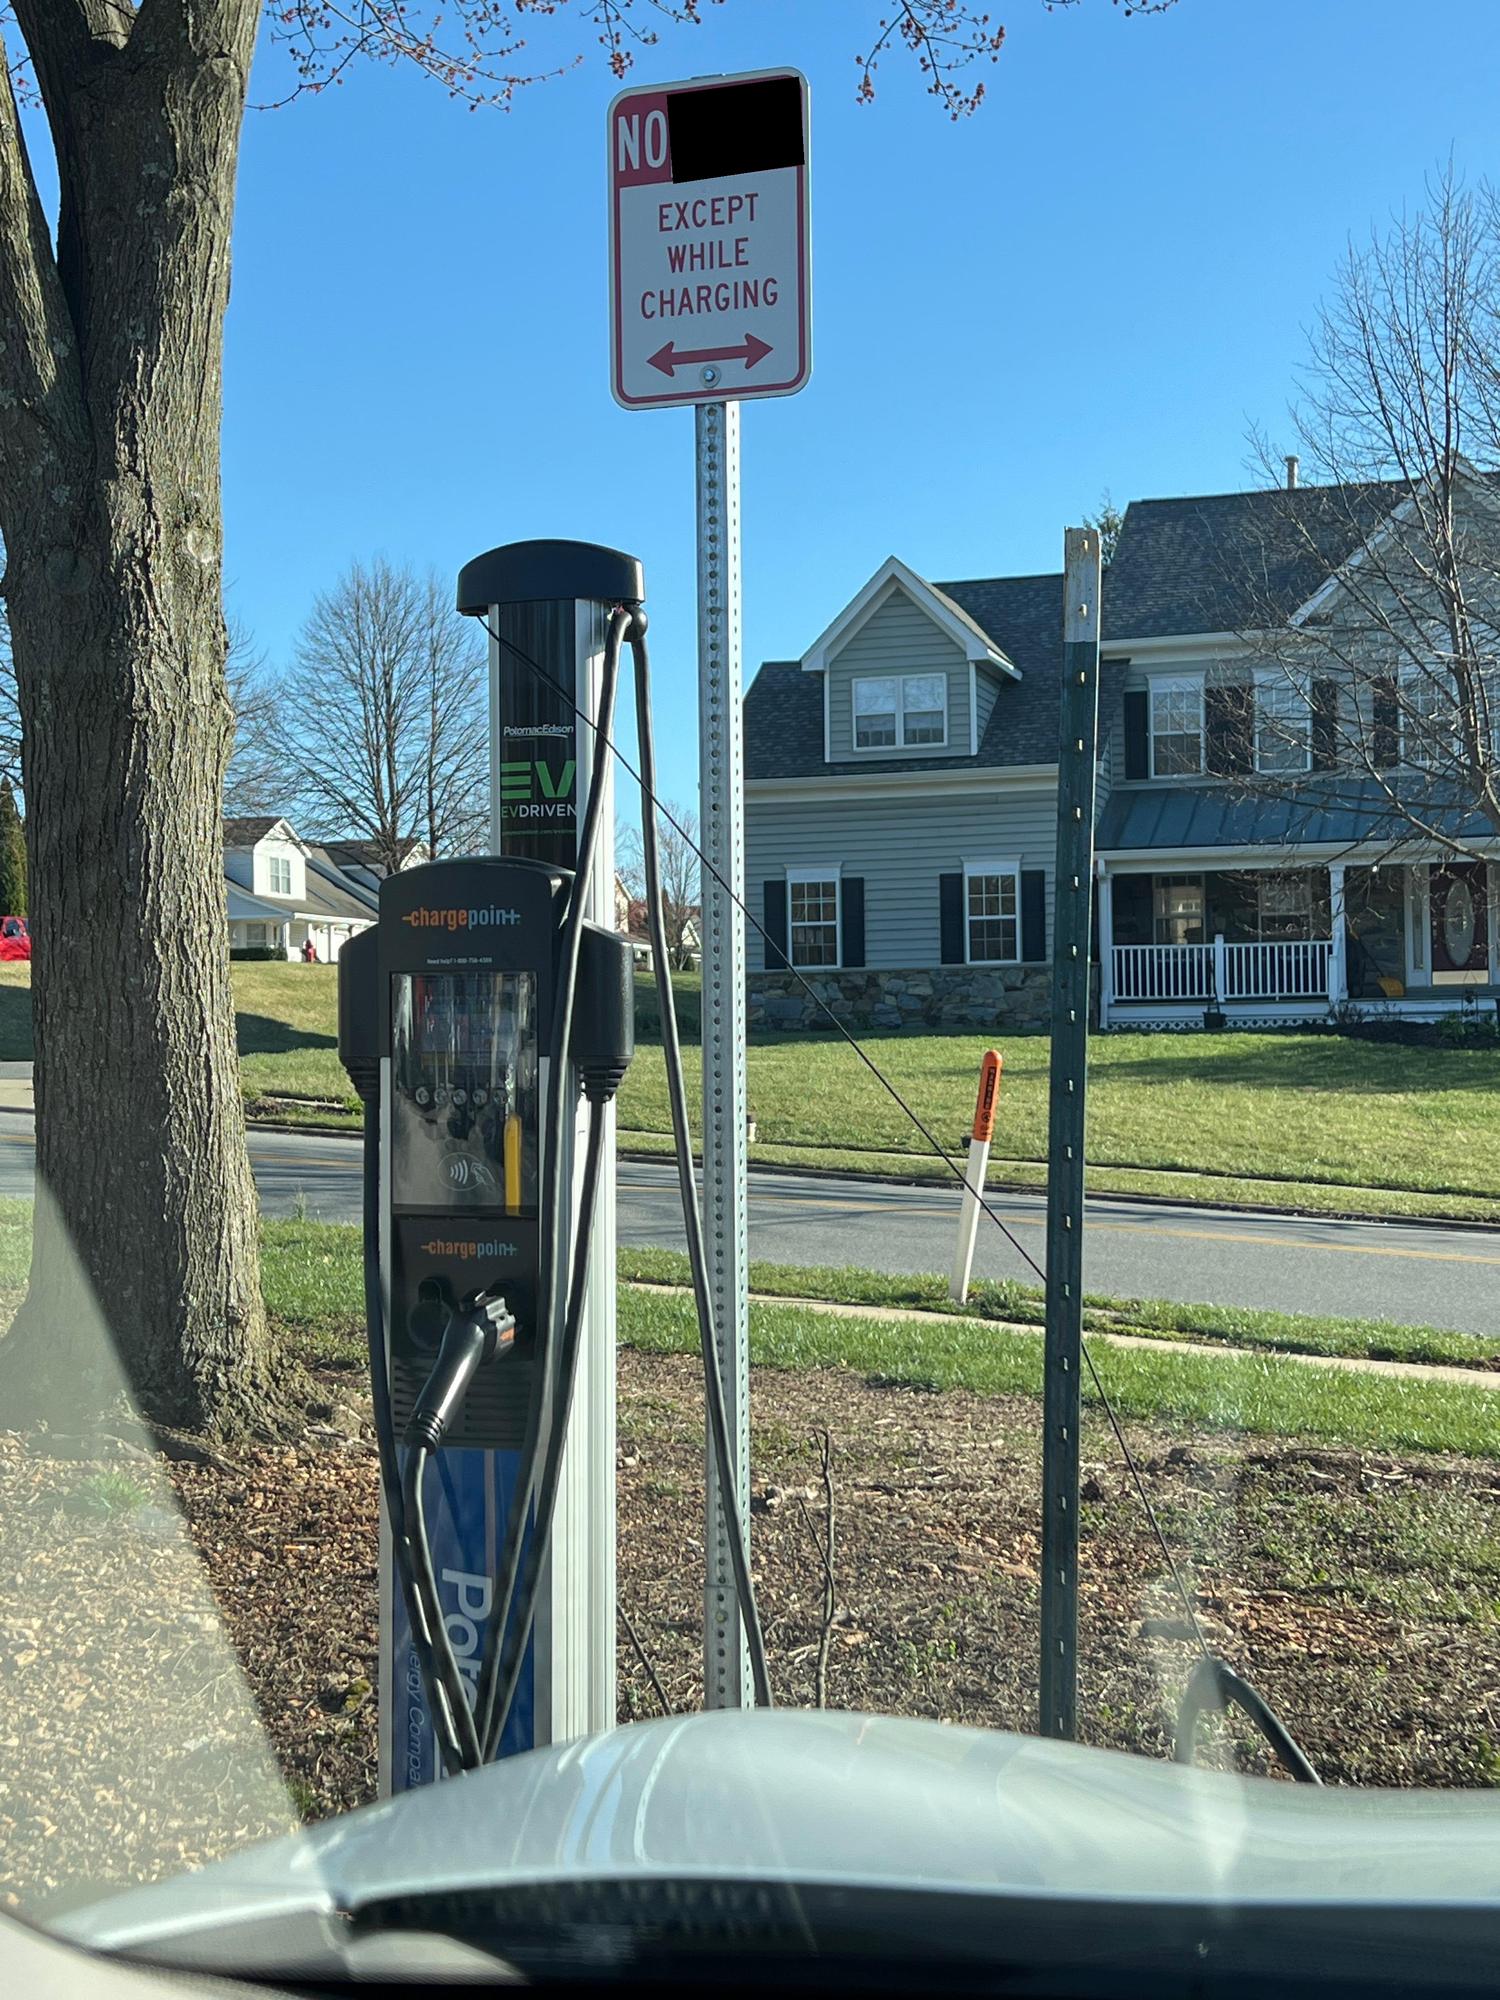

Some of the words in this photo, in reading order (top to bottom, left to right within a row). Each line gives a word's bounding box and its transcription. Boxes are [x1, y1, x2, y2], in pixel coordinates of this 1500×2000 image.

[617, 109, 668, 172] NO
[658, 193, 759, 232] EXCEPT
[667, 237, 749, 274] WHILE
[640, 277, 778, 320] CHARGING
[501, 760, 576, 800] EV
[501, 803, 577, 819] EVDRIVEN
